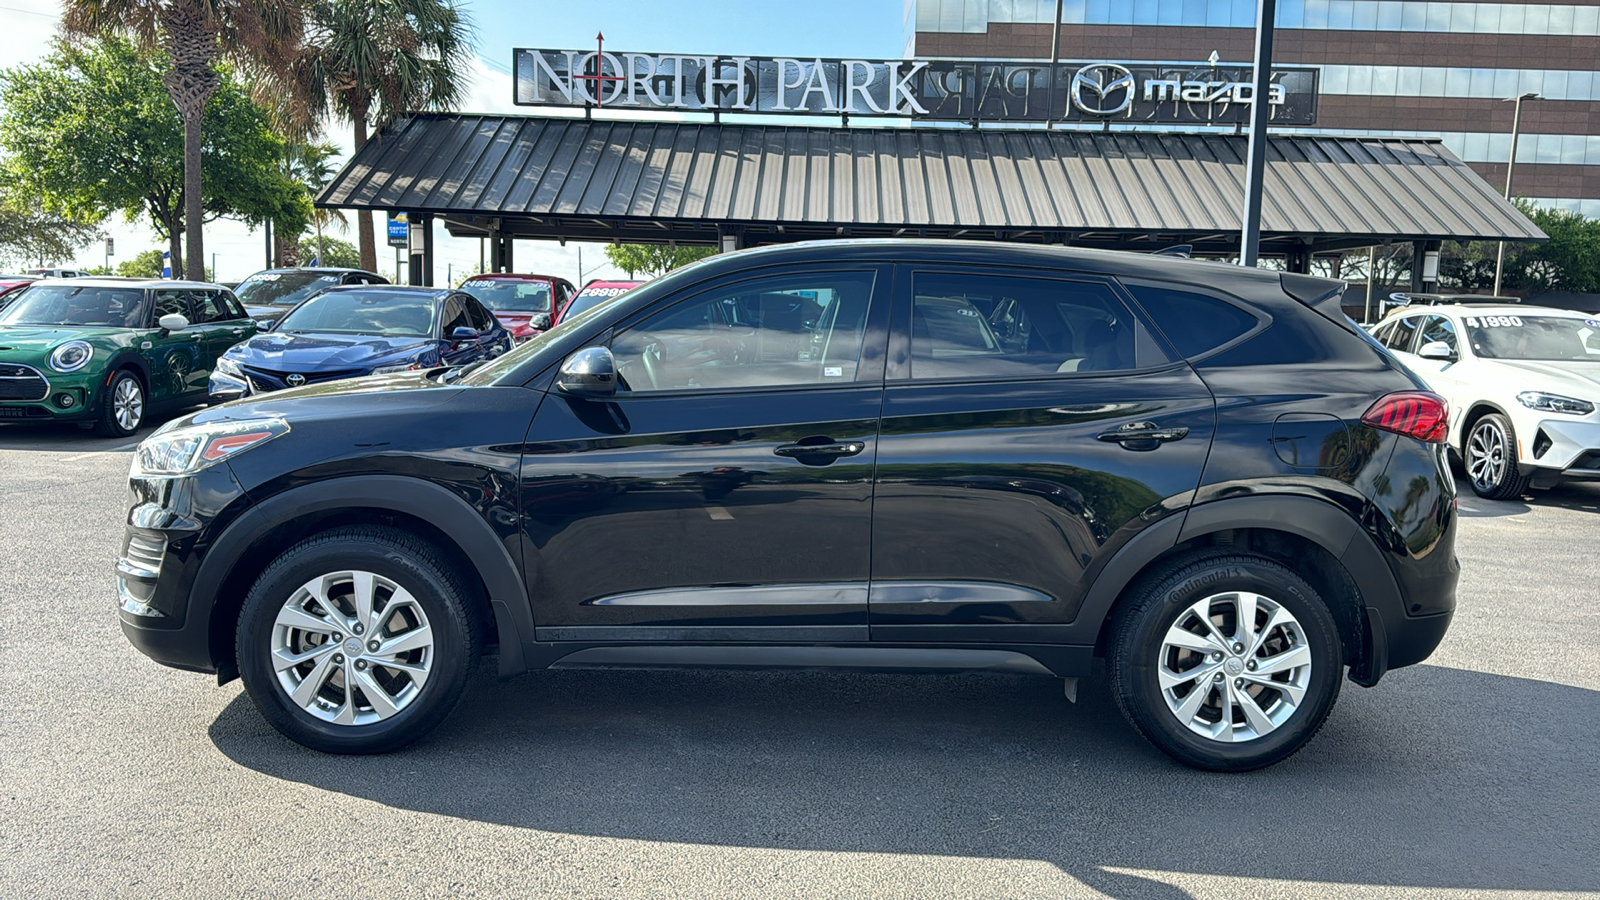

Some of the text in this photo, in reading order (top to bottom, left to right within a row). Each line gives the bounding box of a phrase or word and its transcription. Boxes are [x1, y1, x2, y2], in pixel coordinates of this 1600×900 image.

[526, 50, 750, 108] NORTH
[772, 58, 929, 113] PARK
[462, 280, 496, 288] 24990
[1467, 316, 1524, 329] 41990
[1169, 568, 1231, 604] Continental
